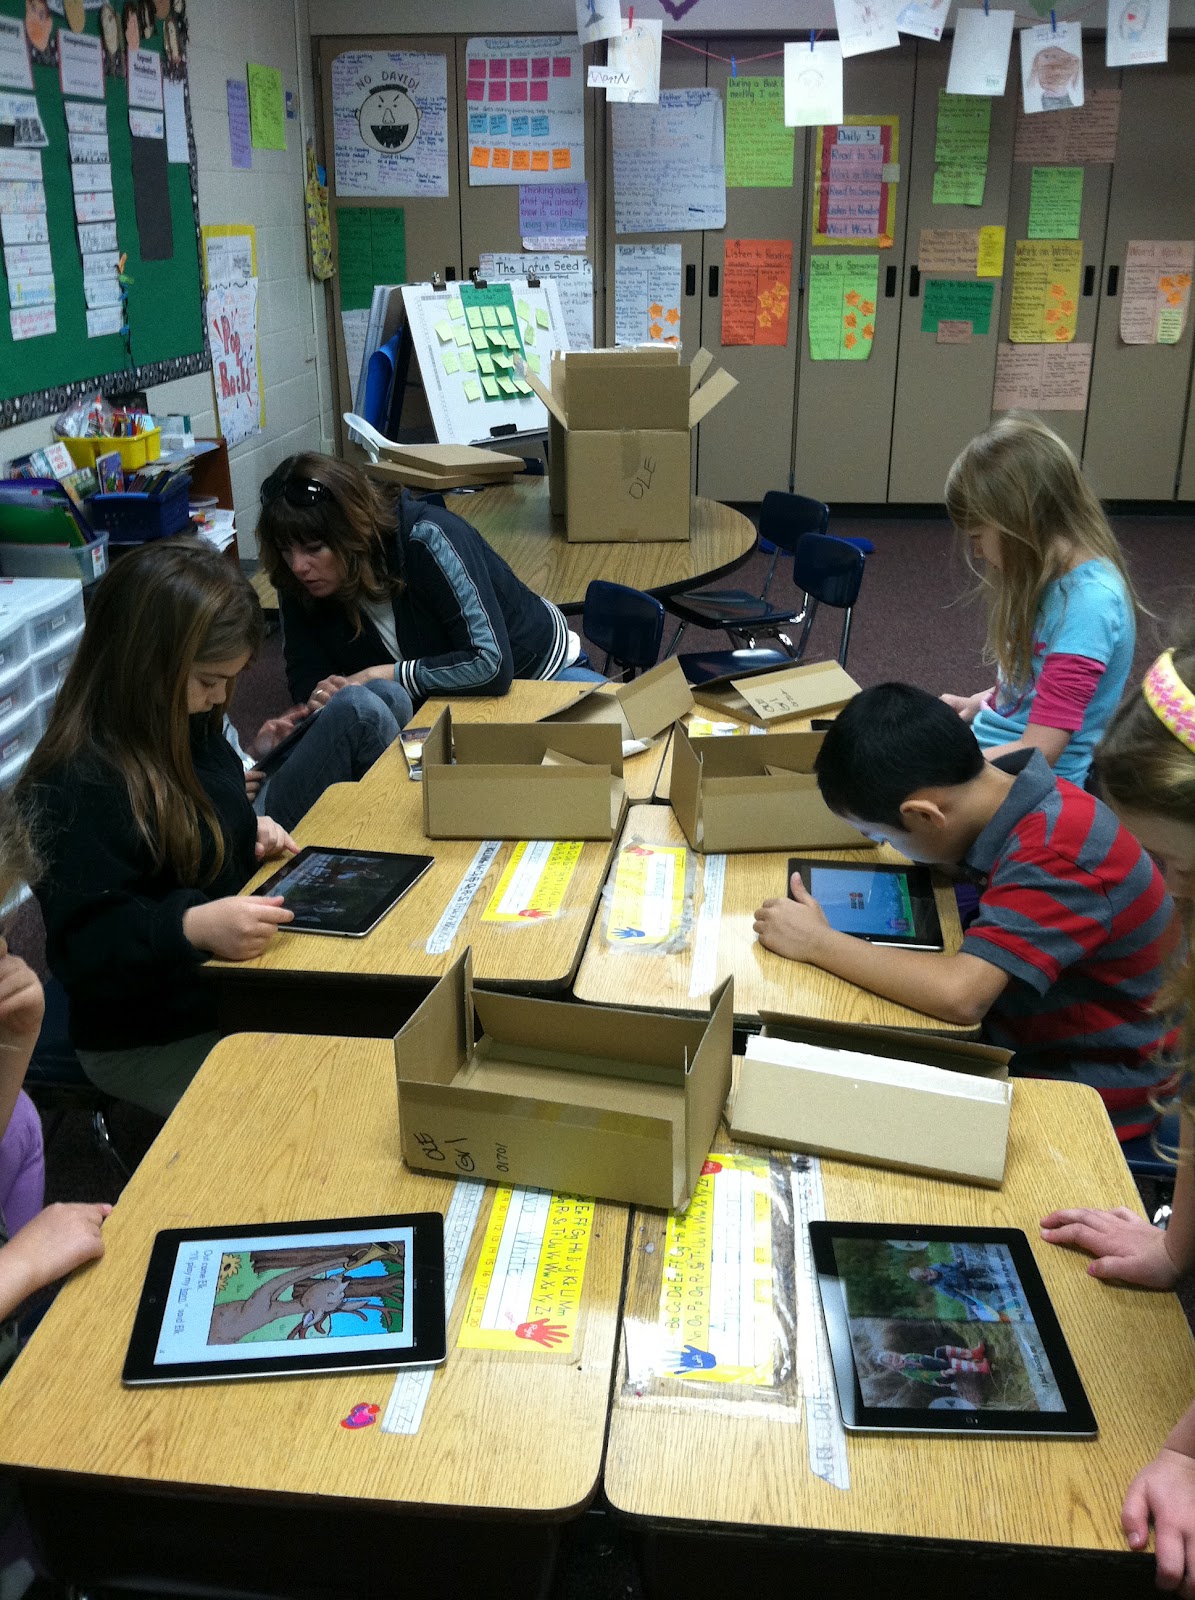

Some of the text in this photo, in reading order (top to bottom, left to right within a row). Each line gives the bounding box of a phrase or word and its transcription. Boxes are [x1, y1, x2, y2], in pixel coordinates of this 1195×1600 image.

[356, 71, 419, 93] NO DAVID!
[838, 131, 860, 141] Daily
[524, 186, 554, 198] Thinking
[520, 197, 583, 209] what you already
[725, 249, 752, 259] Listen
[496, 262, 515, 273] The
[522, 262, 550, 272] Lotus
[554, 260, 579, 271] Seed
[812, 262, 829, 270] Read
[629, 456, 657, 499] OLE
[413, 1132, 445, 1161] OLE
[204, 1250, 213, 1261] Out
[184, 1262, 195, 1275] play
[182, 1277, 191, 1286] my
[175, 1309, 184, 1323] said
[691, 1353, 704, 1368] Left
[1035, 1355, 1044, 1372] boots
[1039, 1373, 1048, 1384] put
